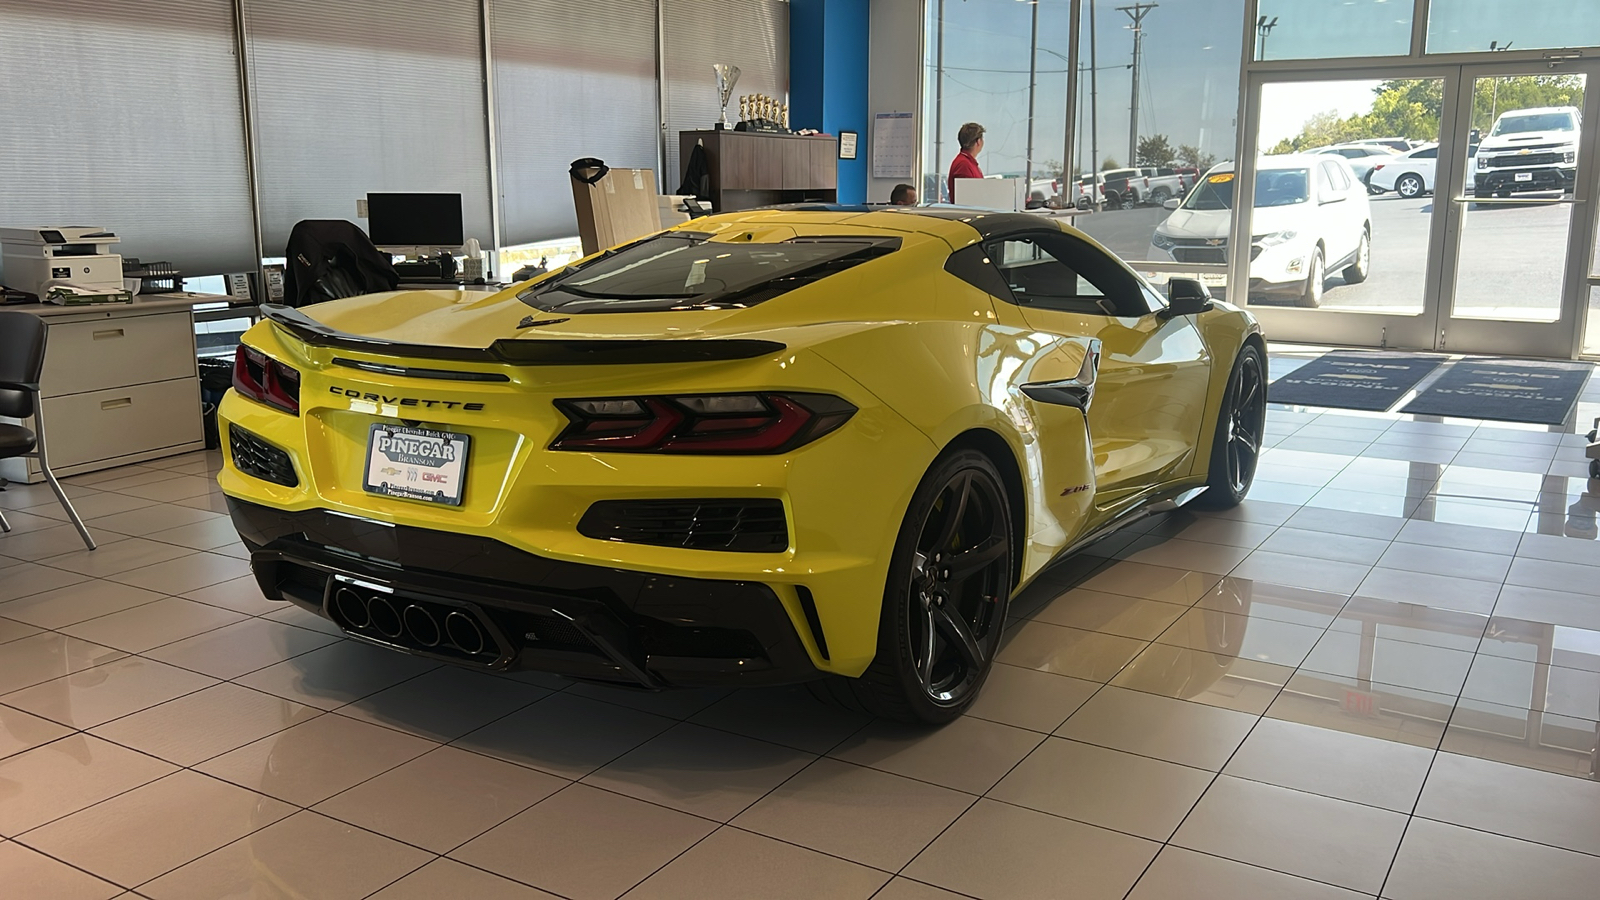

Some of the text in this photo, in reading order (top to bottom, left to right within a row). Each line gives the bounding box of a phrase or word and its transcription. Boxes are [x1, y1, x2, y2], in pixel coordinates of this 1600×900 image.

[329, 385, 486, 411] CORVETTE
[402, 426, 425, 436] Chevrolet
[425, 430, 441, 438] Buick
[379, 437, 455, 461] PINEGAR
[397, 453, 436, 467] BRANSON
[422, 471, 448, 484] GMC
[387, 488, 433, 502] PinegarBranson.com
